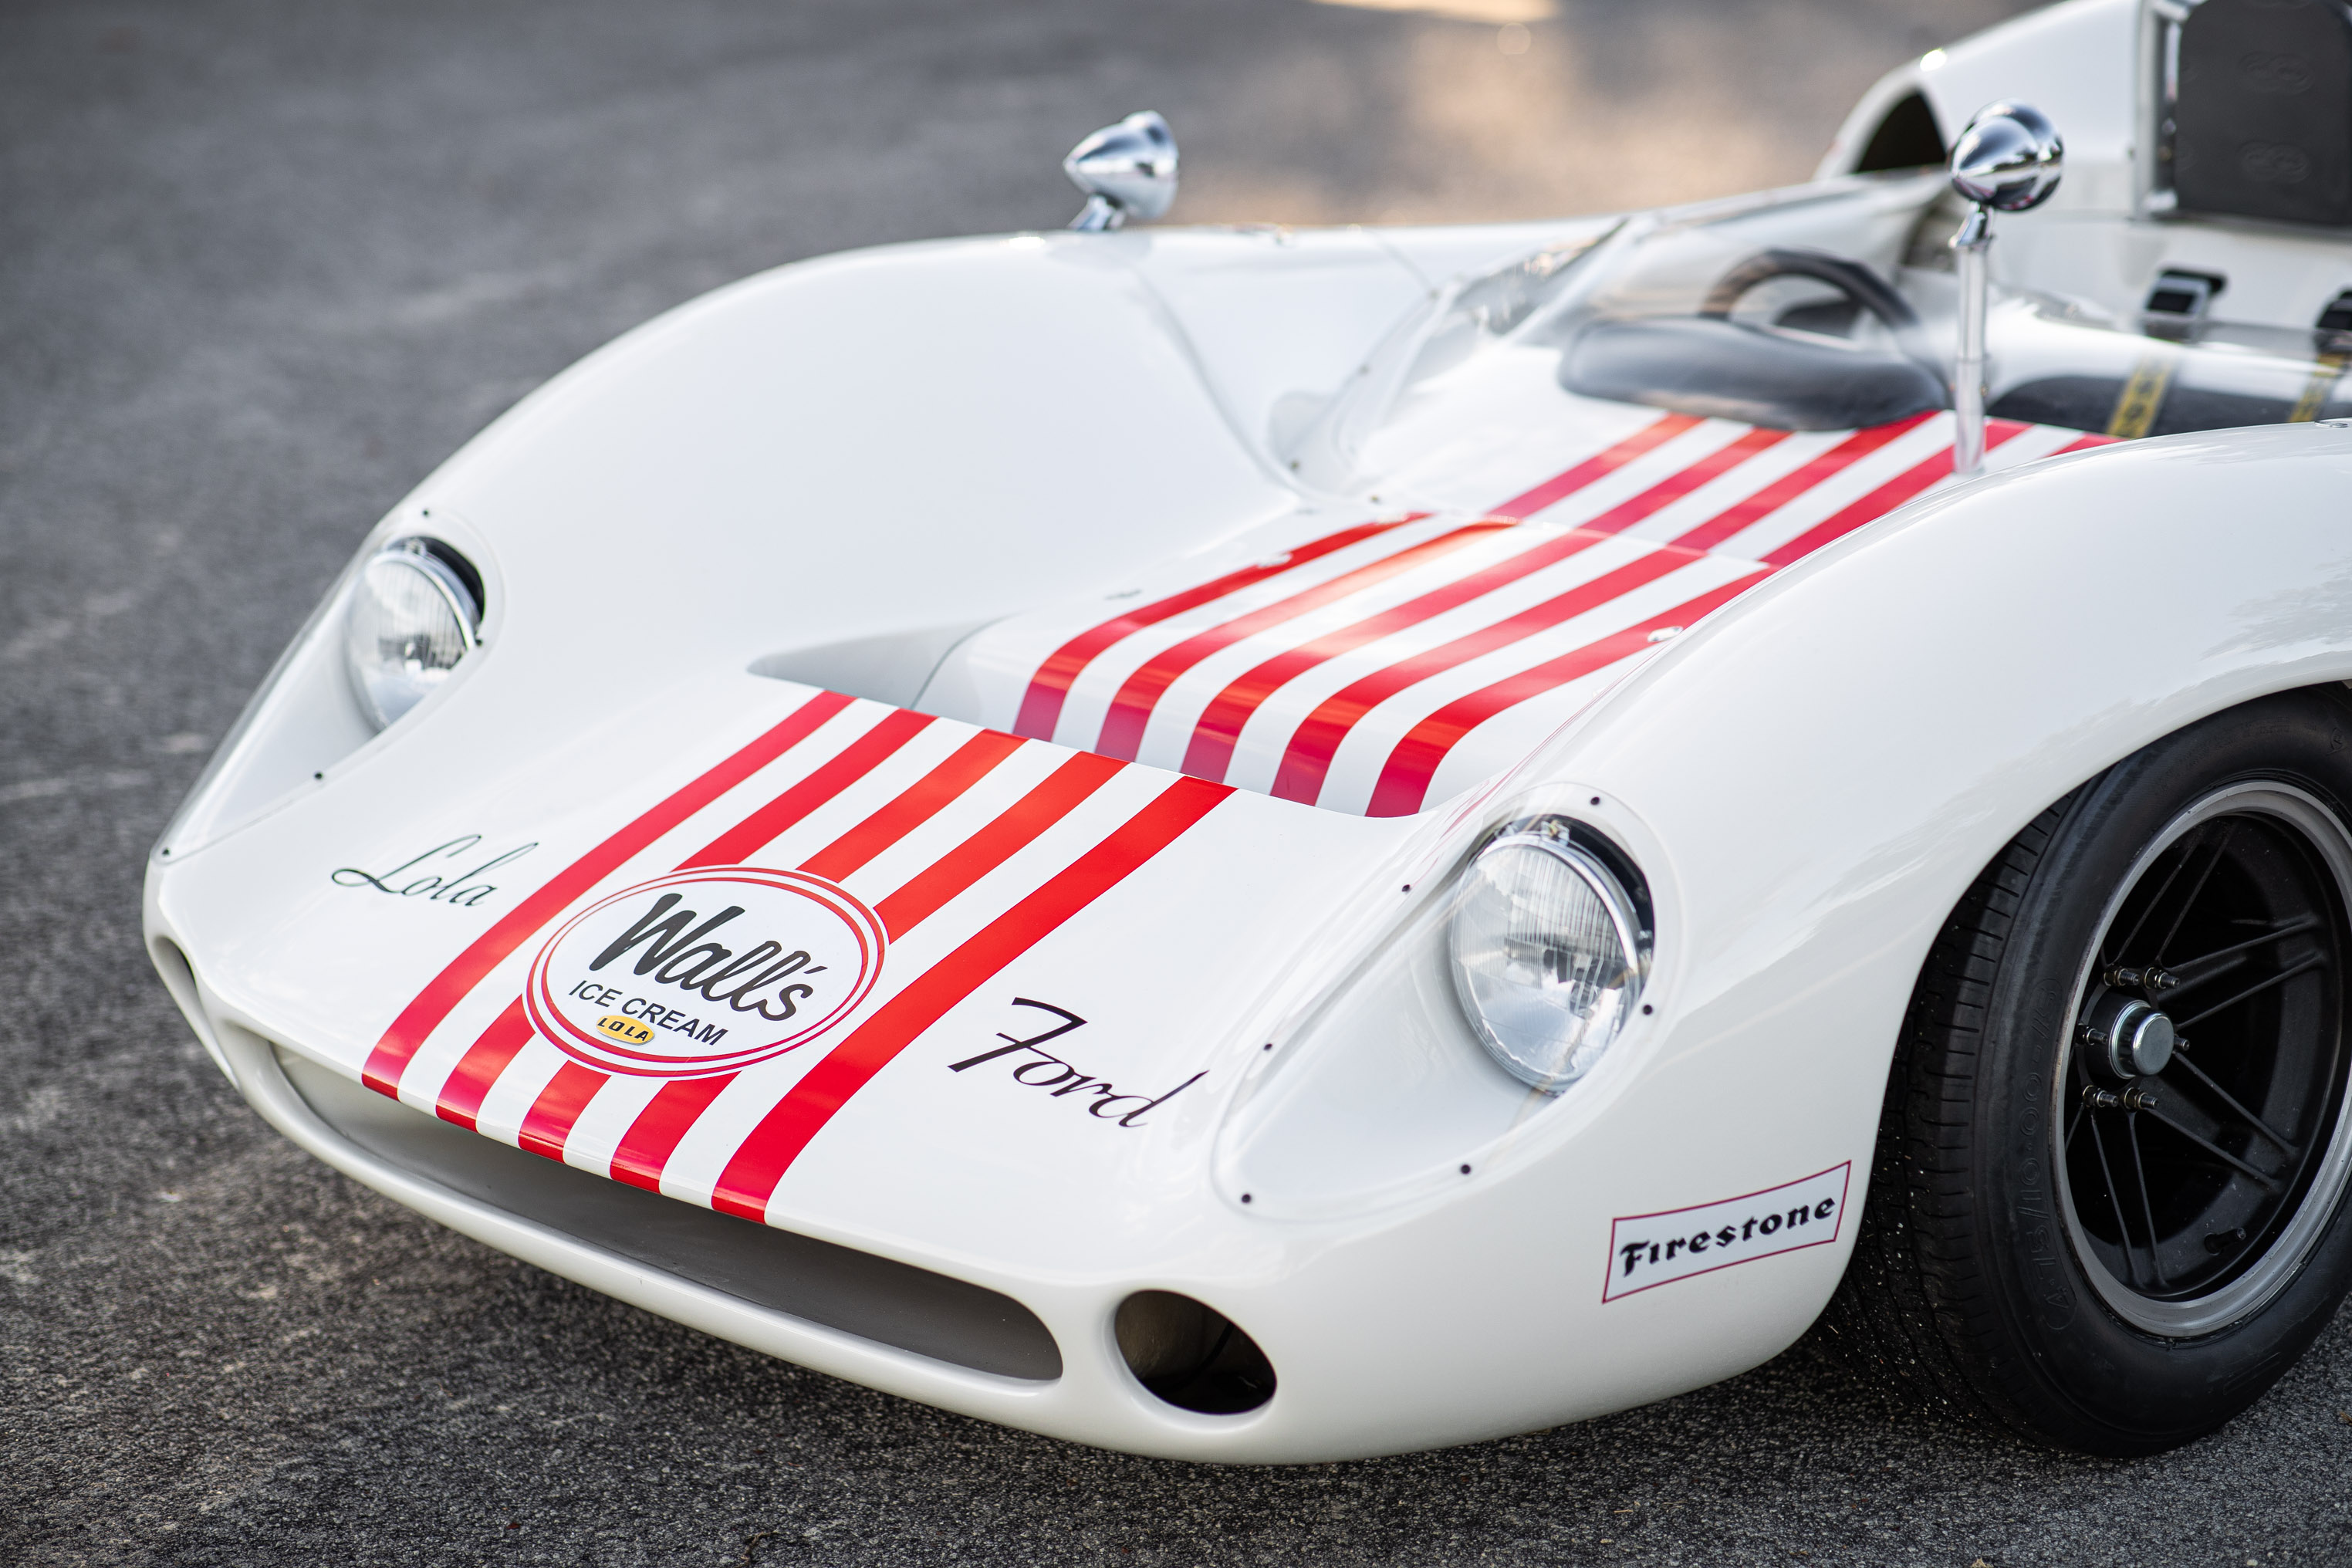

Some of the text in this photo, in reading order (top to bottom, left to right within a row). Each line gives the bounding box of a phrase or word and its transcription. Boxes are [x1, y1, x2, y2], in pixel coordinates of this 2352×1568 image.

[331, 833, 539, 907] Lola
[589, 893, 828, 1022] Wall's
[569, 980, 728, 1046] ICE CREAM
[597, 1017, 649, 1042] LOLA
[948, 997, 1210, 1127] Ford
[1620, 1198, 1835, 1277] Firestone
